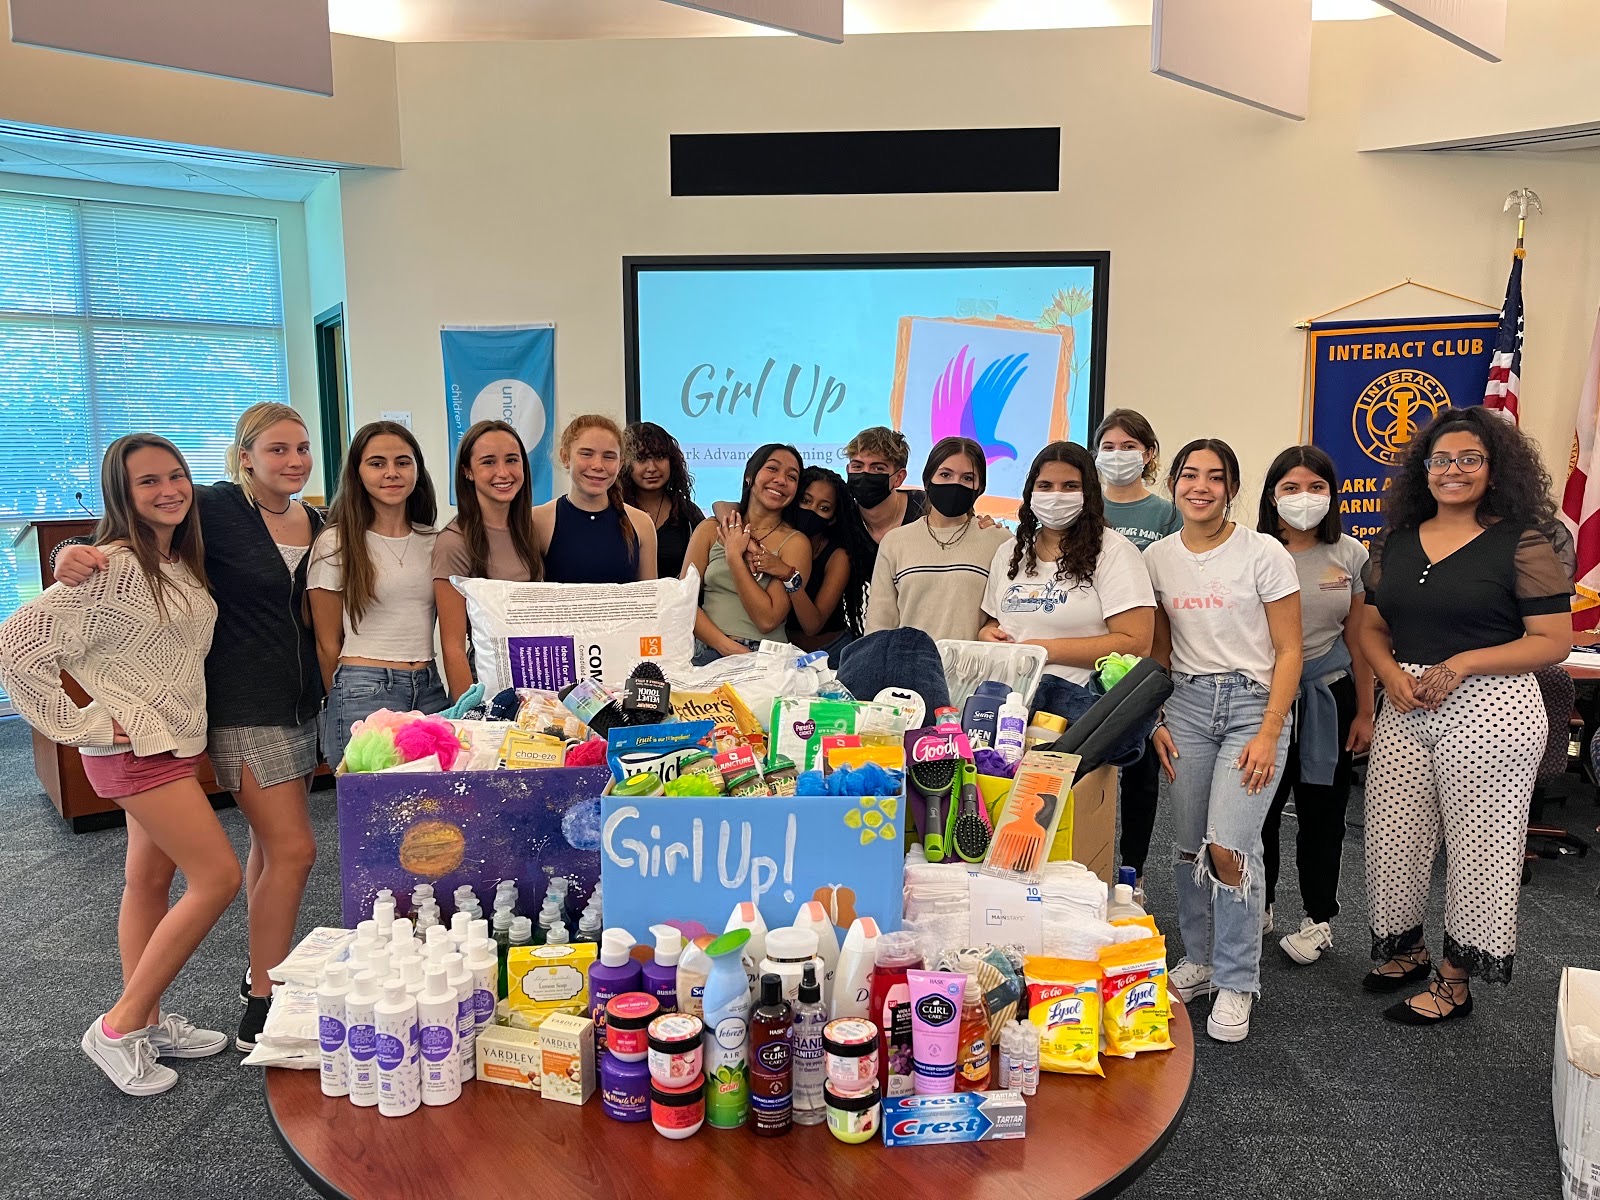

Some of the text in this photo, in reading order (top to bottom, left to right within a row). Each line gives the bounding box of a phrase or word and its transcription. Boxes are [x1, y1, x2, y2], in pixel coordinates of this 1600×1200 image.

[1329, 338, 1483, 361] INTERACT CLUB
[1363, 372, 1444, 402] INTERACT
[681, 357, 846, 437] Girl Up
[501, 386, 516, 427] unice
[703, 448, 753, 460] Advanc
[801, 448, 832, 463] ning
[1338, 478, 1377, 493] ARK
[1340, 498, 1381, 513] ARNI
[1172, 594, 1224, 609] Levi's
[561, 646, 569, 663] Ideal
[588, 644, 603, 683] COM
[543, 667, 551, 685] wicking
[636, 694, 660, 703] VELVET
[637, 688, 660, 697] TOUCH
[636, 736, 652, 746] Fruit
[968, 728, 991, 740] MEN
[912, 734, 960, 762] Goody
[719, 757, 752, 770] JUNCTURE
[603, 806, 797, 906] Girl Up!
[1027, 887, 1038, 895] 10
[1012, 944, 1025, 952] Set
[1116, 974, 1137, 989] To Go
[1039, 987, 1062, 999] To Go
[1125, 985, 1155, 1008] Lysol
[922, 1005, 948, 1015] CURL
[1049, 1001, 1081, 1022] Lysol
[552, 1018, 582, 1028] YARDLEY
[718, 1026, 745, 1038] febreze
[541, 1037, 579, 1049] YARDLEY
[483, 1047, 534, 1064] YARDLEY
[763, 1050, 788, 1060] CURL
[719, 1082, 739, 1093] Gain
[898, 1095, 970, 1108] Crest
[997, 1115, 1023, 1123] TARTAR
[892, 1117, 980, 1138] Crest
